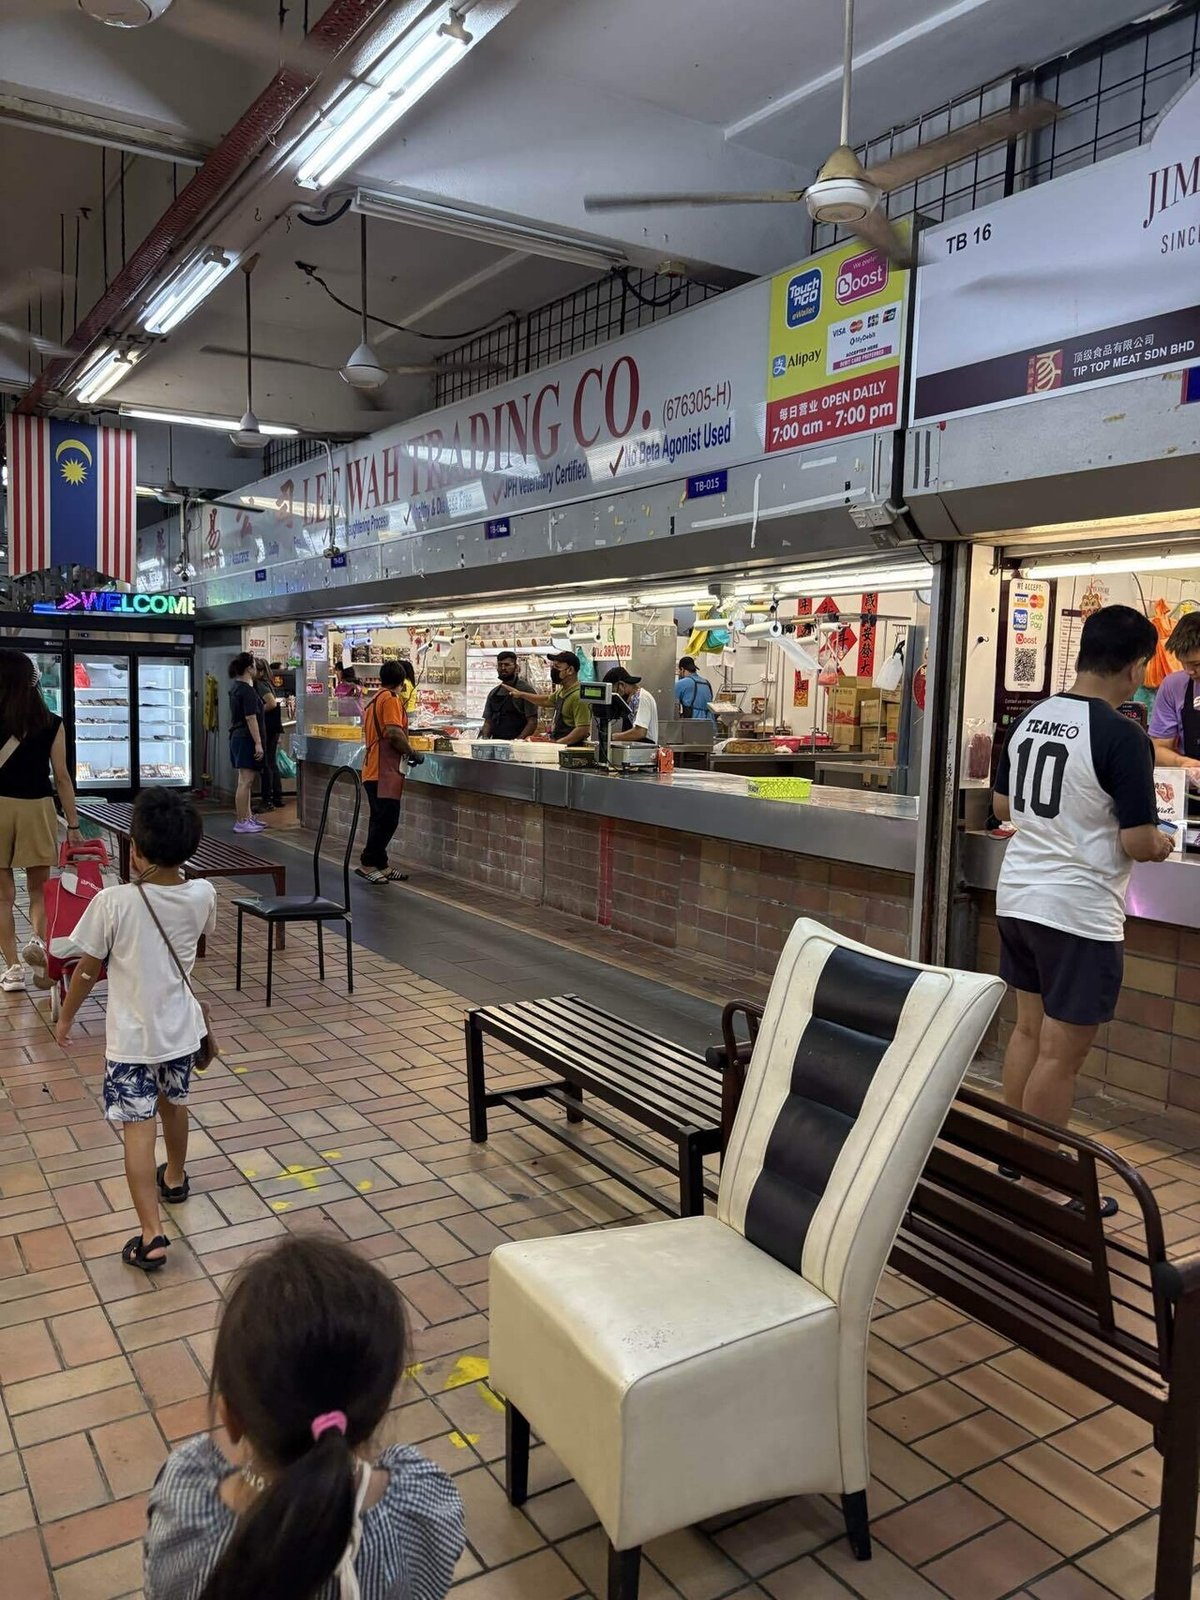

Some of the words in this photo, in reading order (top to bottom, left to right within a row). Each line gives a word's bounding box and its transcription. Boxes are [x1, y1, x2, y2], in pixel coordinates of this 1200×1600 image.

[946, 232, 967, 254] TB
[974, 223, 991, 245] 16
[1161, 225, 1200, 254] SINC
[789, 277, 820, 299] Touch
[832, 327, 846, 338] VISA
[788, 349, 821, 368] Alipay
[1072, 365, 1088, 377] TIP
[1091, 361, 1110, 373] TOP
[1113, 353, 1141, 369] MEAT
[1144, 346, 1167, 361] SDN
[1171, 340, 1195, 355] BHD
[1074, 333, 1155, 364] 顶级食品有限公司
[780, 400, 818, 420] 每日营业
[822, 390, 850, 409] OPEN
[853, 380, 886, 400] DAILY
[346, 446, 401, 512] WAH
[408, 381, 562, 497] TRADING
[573, 356, 651, 449] CO.
[663, 380, 731, 428] (676305-H)
[772, 422, 799, 444] 7:00
[802, 420, 822, 436] am
[835, 404, 865, 428] 7:00
[870, 402, 893, 425] pm
[624, 445, 636, 468] No
[640, 441, 660, 464] Beta
[662, 428, 701, 463] Agonist
[704, 417, 731, 448] Used
[504, 477, 517, 498] JPH
[555, 460, 587, 485] Certified
[695, 478, 720, 492] TB-015
[81, 592, 196, 615] WELCOME
[1030, 611, 1044, 622] Grab
[1030, 621, 1042, 631] Pay
[1013, 738, 1069, 819] 10
